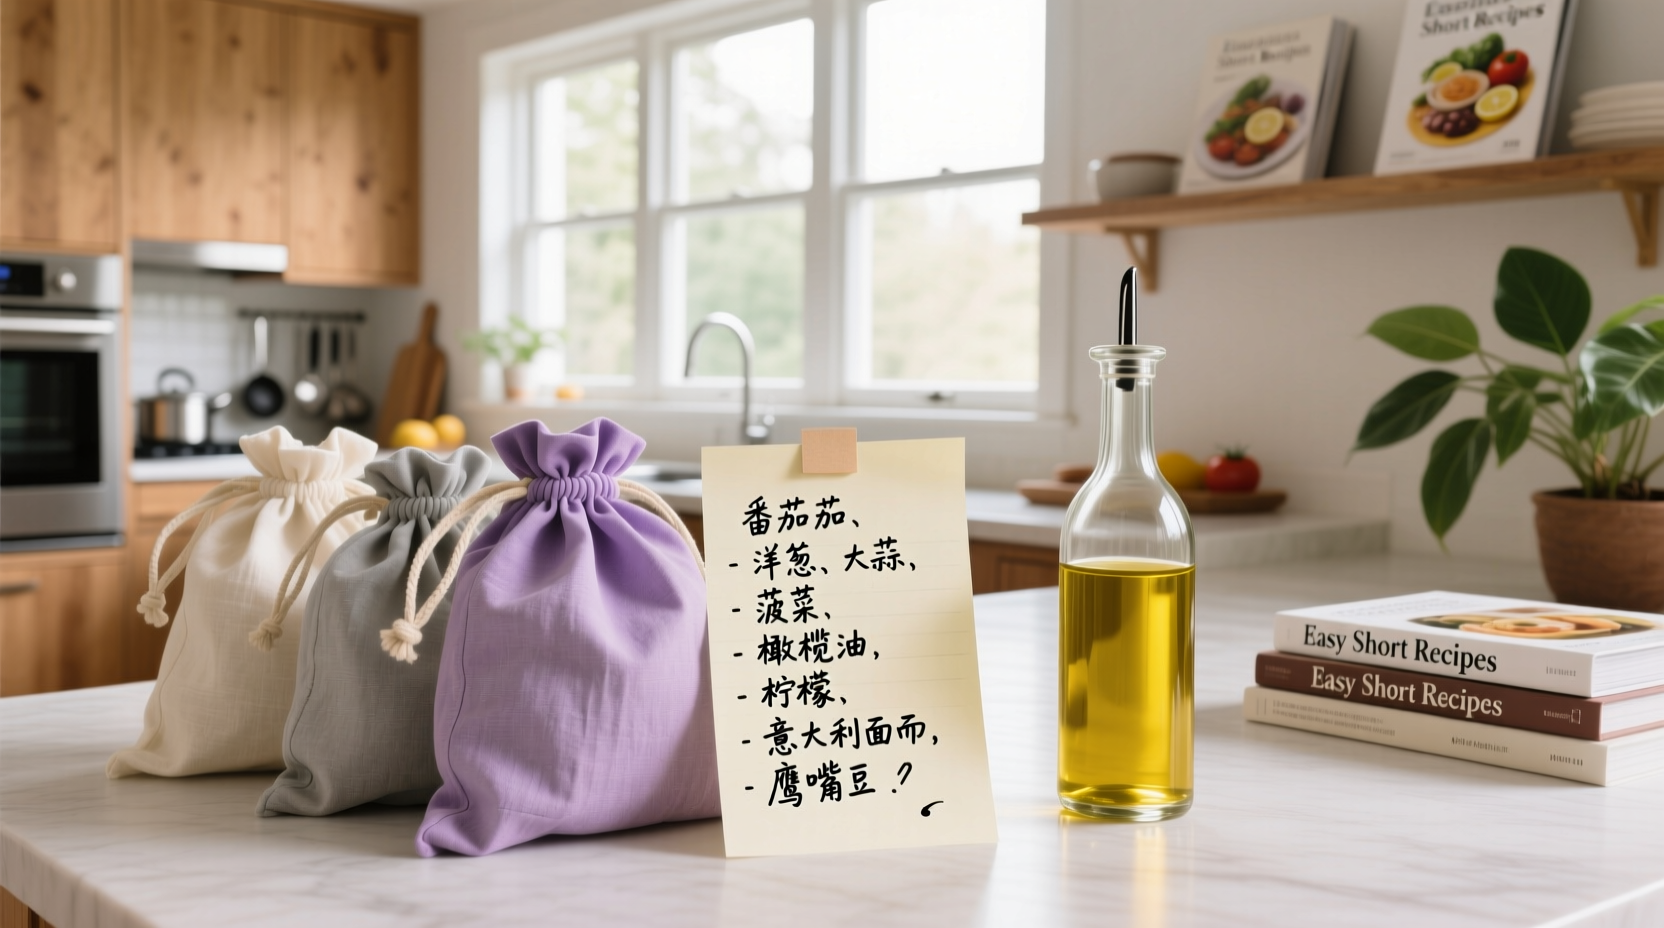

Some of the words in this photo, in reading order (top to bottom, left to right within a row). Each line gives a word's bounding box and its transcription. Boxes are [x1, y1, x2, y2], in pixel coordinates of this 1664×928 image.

[1303, 623, 1347, 656] Easy
[1352, 629, 1408, 660] Short
[1414, 637, 1498, 675] Recipes
[1310, 664, 1356, 699] Easy
[1361, 672, 1416, 704] Short
[1421, 681, 1504, 719] Recipes
